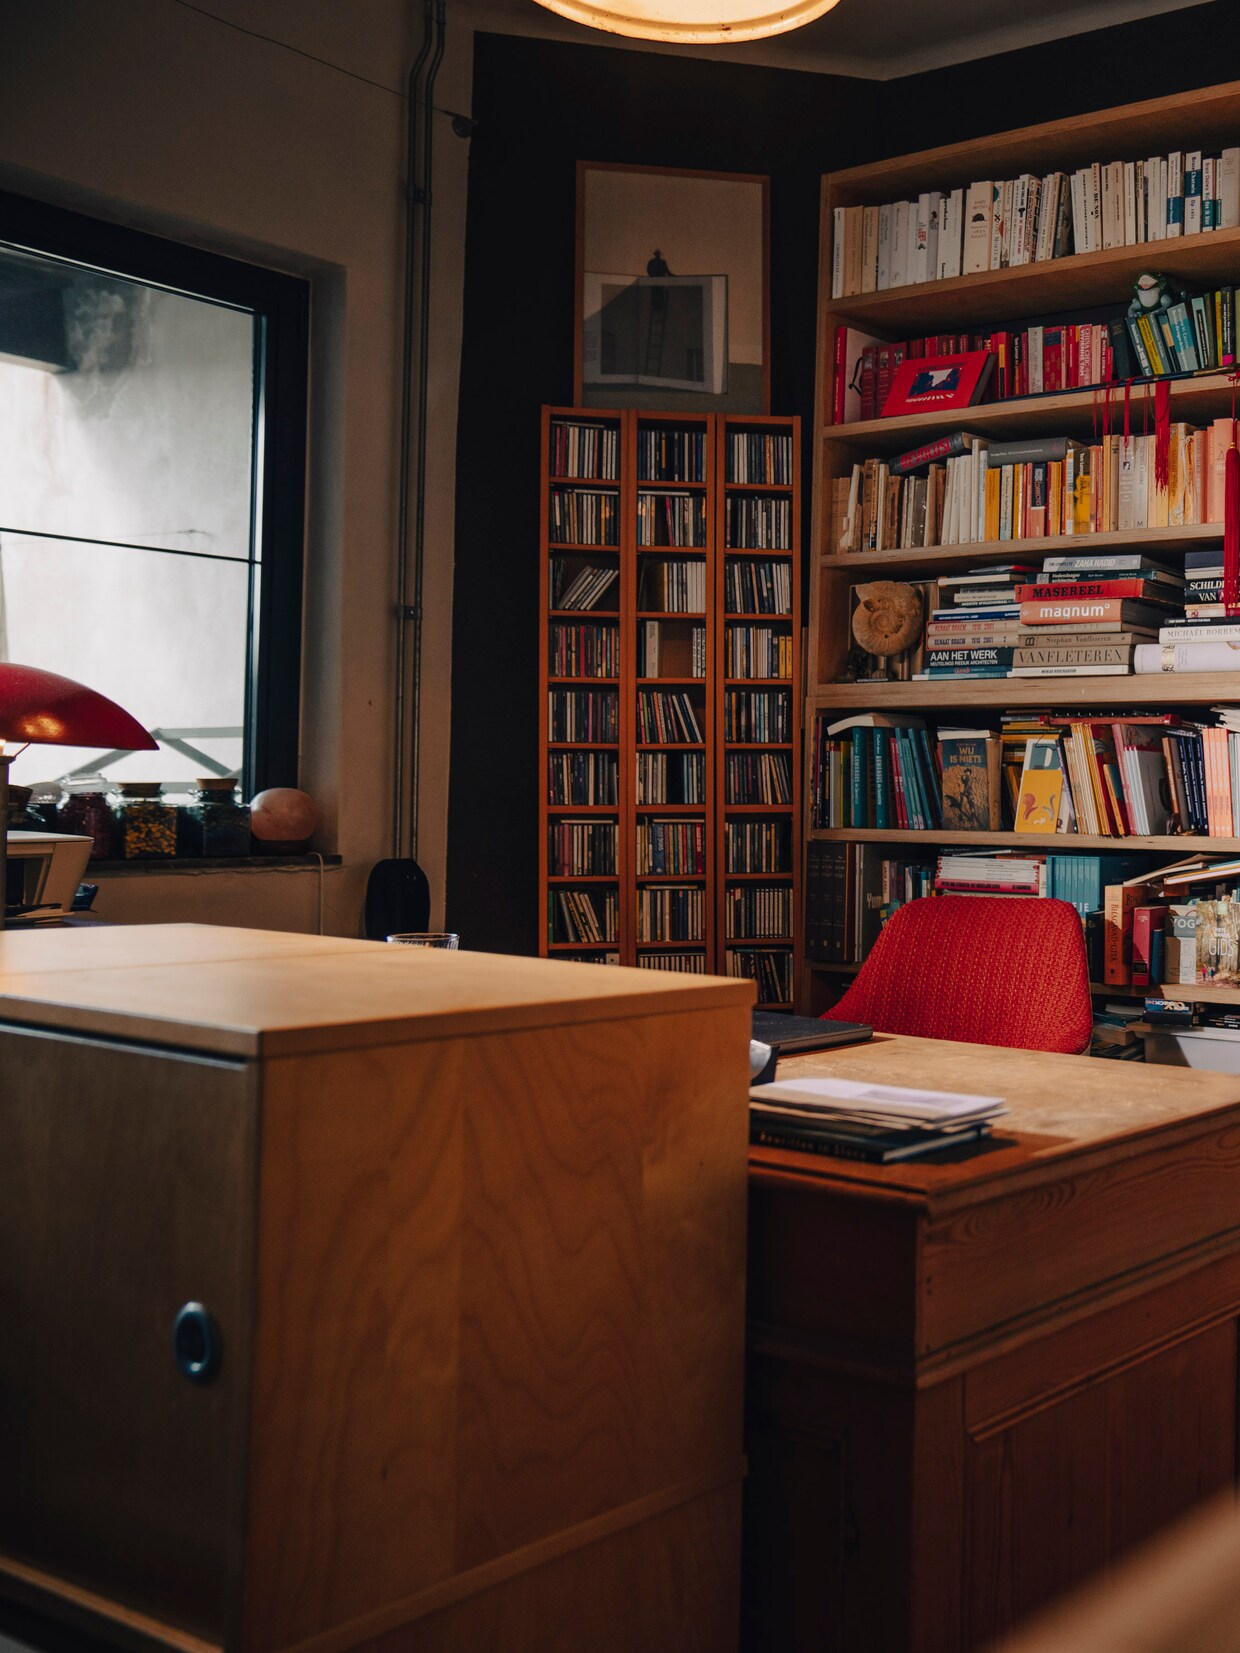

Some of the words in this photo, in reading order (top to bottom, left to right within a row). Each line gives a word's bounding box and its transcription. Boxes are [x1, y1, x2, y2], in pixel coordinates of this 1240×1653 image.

[1074, 559, 1095, 568] ZAHA
[1094, 558, 1116, 568] HADID
[1032, 585, 1104, 599] MASEREEL
[1198, 592, 1217, 601] VAN
[1167, 628, 1205, 638] MICHAËL
[1046, 636, 1072, 645] Stephan
[1075, 636, 1112, 644] Vanfleteren
[930, 650, 950, 662] AAN
[950, 650, 970, 661] HET
[970, 649, 997, 660] WERK
[1018, 646, 1123, 664] VANFLETEREN
[958, 747, 974, 756] WIJ
[950, 756, 957, 764] IS
[958, 756, 982, 764] NIETS
[1208, 938, 1234, 957] GIDS
